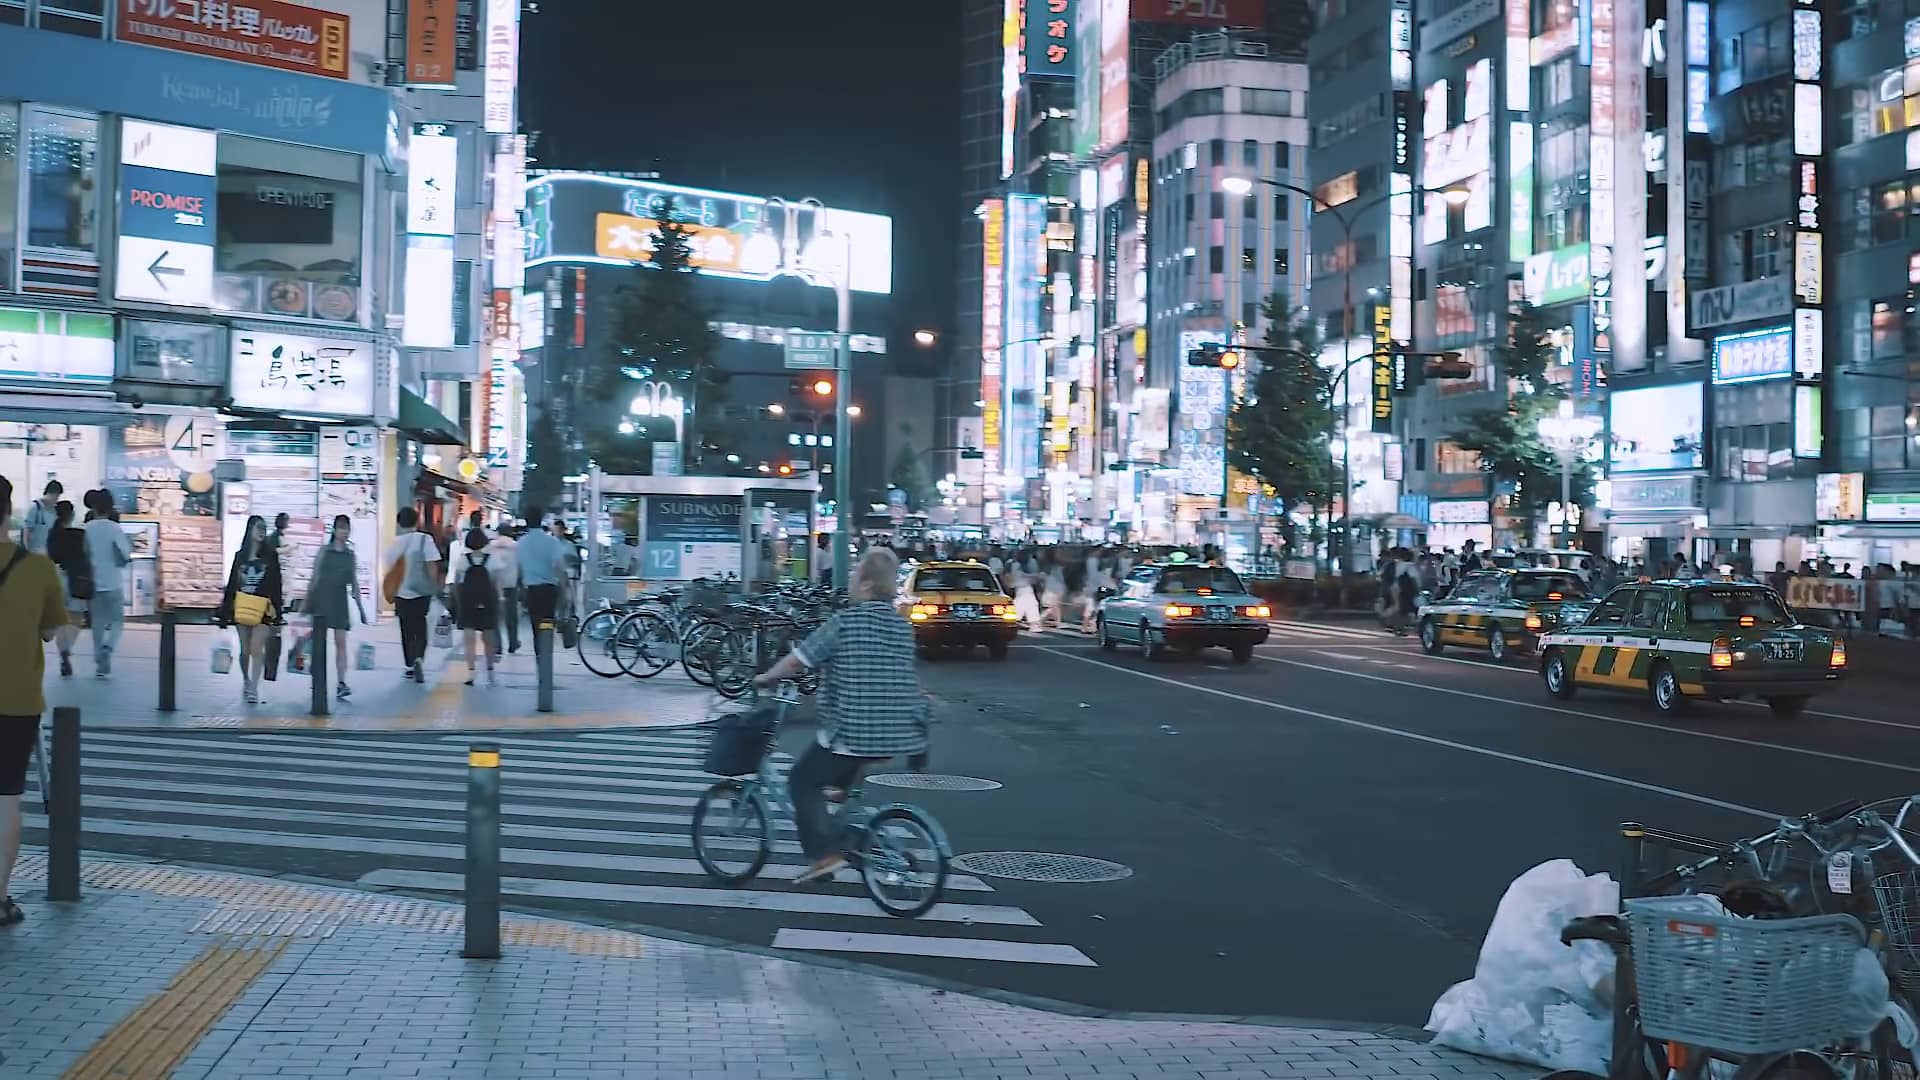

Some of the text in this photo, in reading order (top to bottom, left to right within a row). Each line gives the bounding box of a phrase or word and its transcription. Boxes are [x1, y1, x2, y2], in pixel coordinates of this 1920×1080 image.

[130, 188, 204, 214] PROMISE
[171, 418, 216, 458] 4F
[659, 501, 744, 518] SUBNADE
[649, 548, 677, 569] 12
